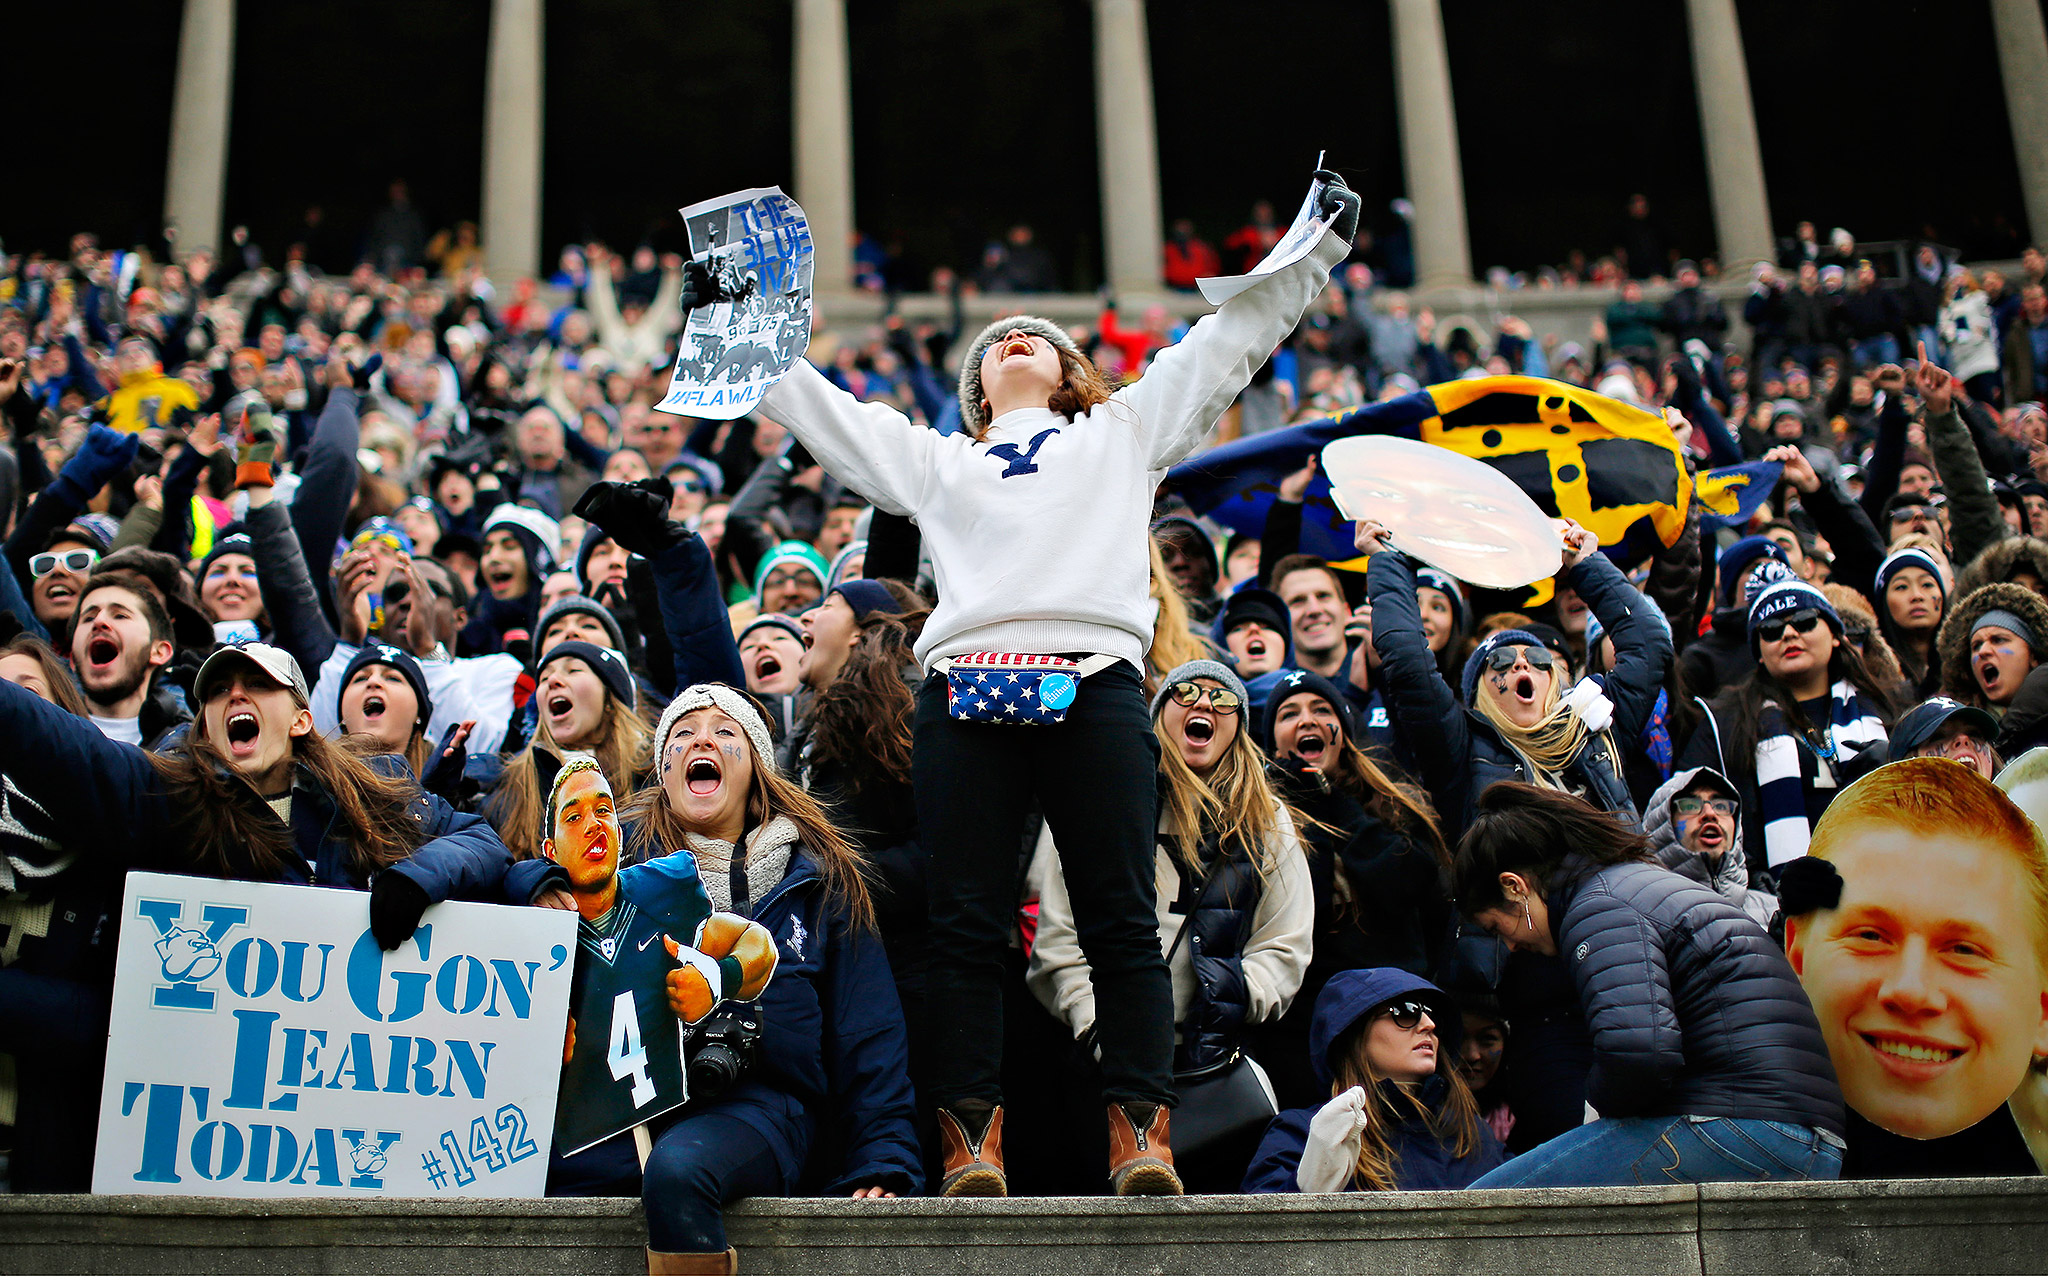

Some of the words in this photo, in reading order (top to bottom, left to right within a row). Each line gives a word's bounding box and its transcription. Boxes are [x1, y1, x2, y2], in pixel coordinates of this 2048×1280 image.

[732, 196, 795, 236] THE
[742, 220, 813, 270] BLUE
[759, 256, 802, 298] IVY
[985, 427, 1061, 480] Y
[1758, 594, 1798, 621] YALE
[377, 644, 402, 662] Y
[1046, 679, 1071, 704] Elihu?
[1284, 670, 1307, 687] Y
[1326, 722, 1339, 746] Y
[222, 1009, 497, 1112] LEARN
[606, 989, 658, 1110] 4
[421, 1103, 540, 1191] #142
